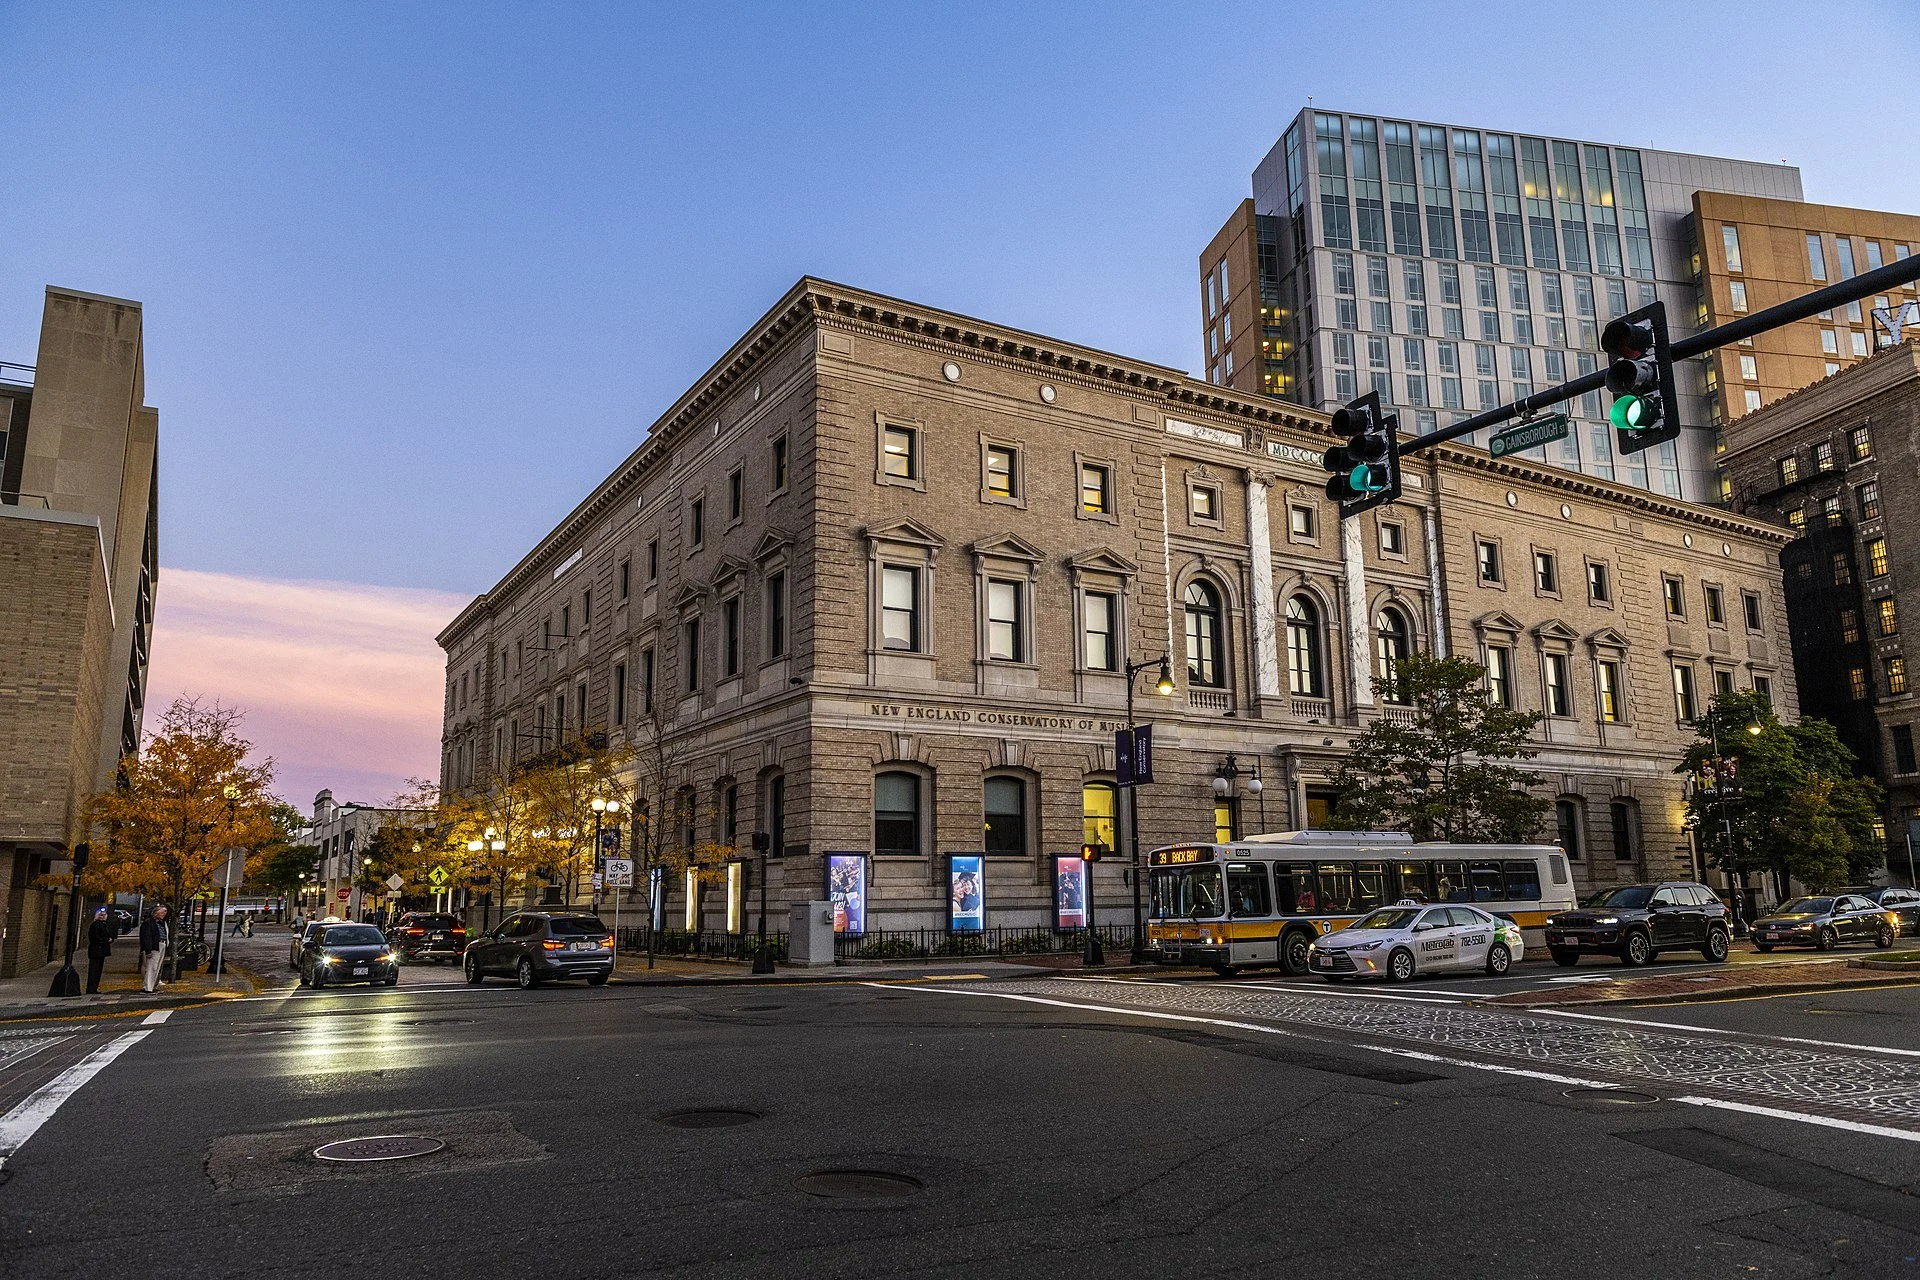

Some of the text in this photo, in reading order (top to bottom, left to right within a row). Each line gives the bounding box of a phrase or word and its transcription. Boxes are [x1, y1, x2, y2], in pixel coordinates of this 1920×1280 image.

[1505, 422, 1558, 450] GAINSBOROUGH
[871, 704, 1133, 731] NEW ENGLAND CONSERVATORY OF MUSI
[1159, 850, 1198, 864] 39 BACK BAY
